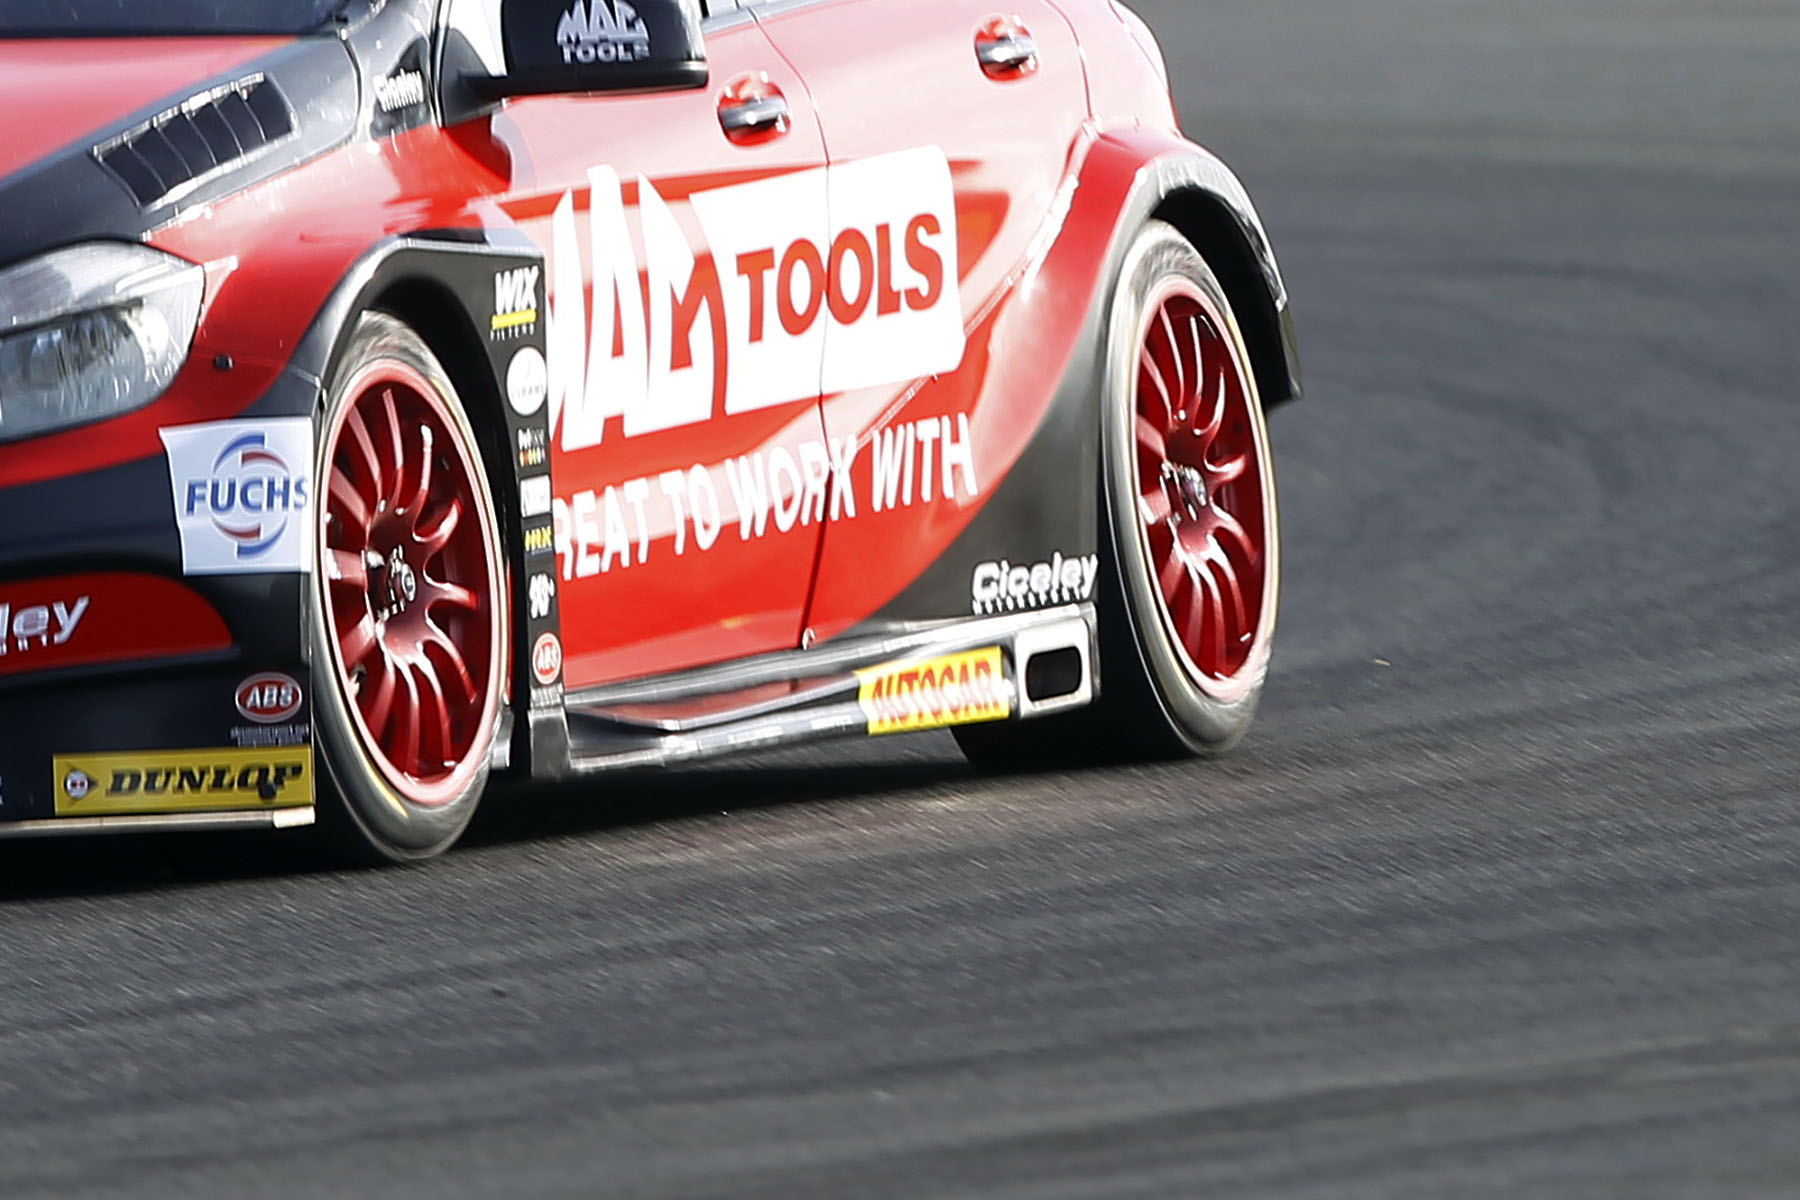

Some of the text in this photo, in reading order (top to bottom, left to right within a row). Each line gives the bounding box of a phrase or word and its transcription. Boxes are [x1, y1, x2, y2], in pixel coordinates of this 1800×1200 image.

[561, 41, 651, 64] TOOLS
[495, 265, 540, 316] WIX
[735, 211, 944, 345] TOOLS
[185, 475, 309, 516] FUCHS
[553, 412, 979, 582] REAT TO WORK WITH
[972, 551, 1098, 601] Ciceley
[245, 683, 294, 709] ABS
[872, 657, 1000, 726] AUTOCAR
[105, 762, 304, 798] DUNLOP
